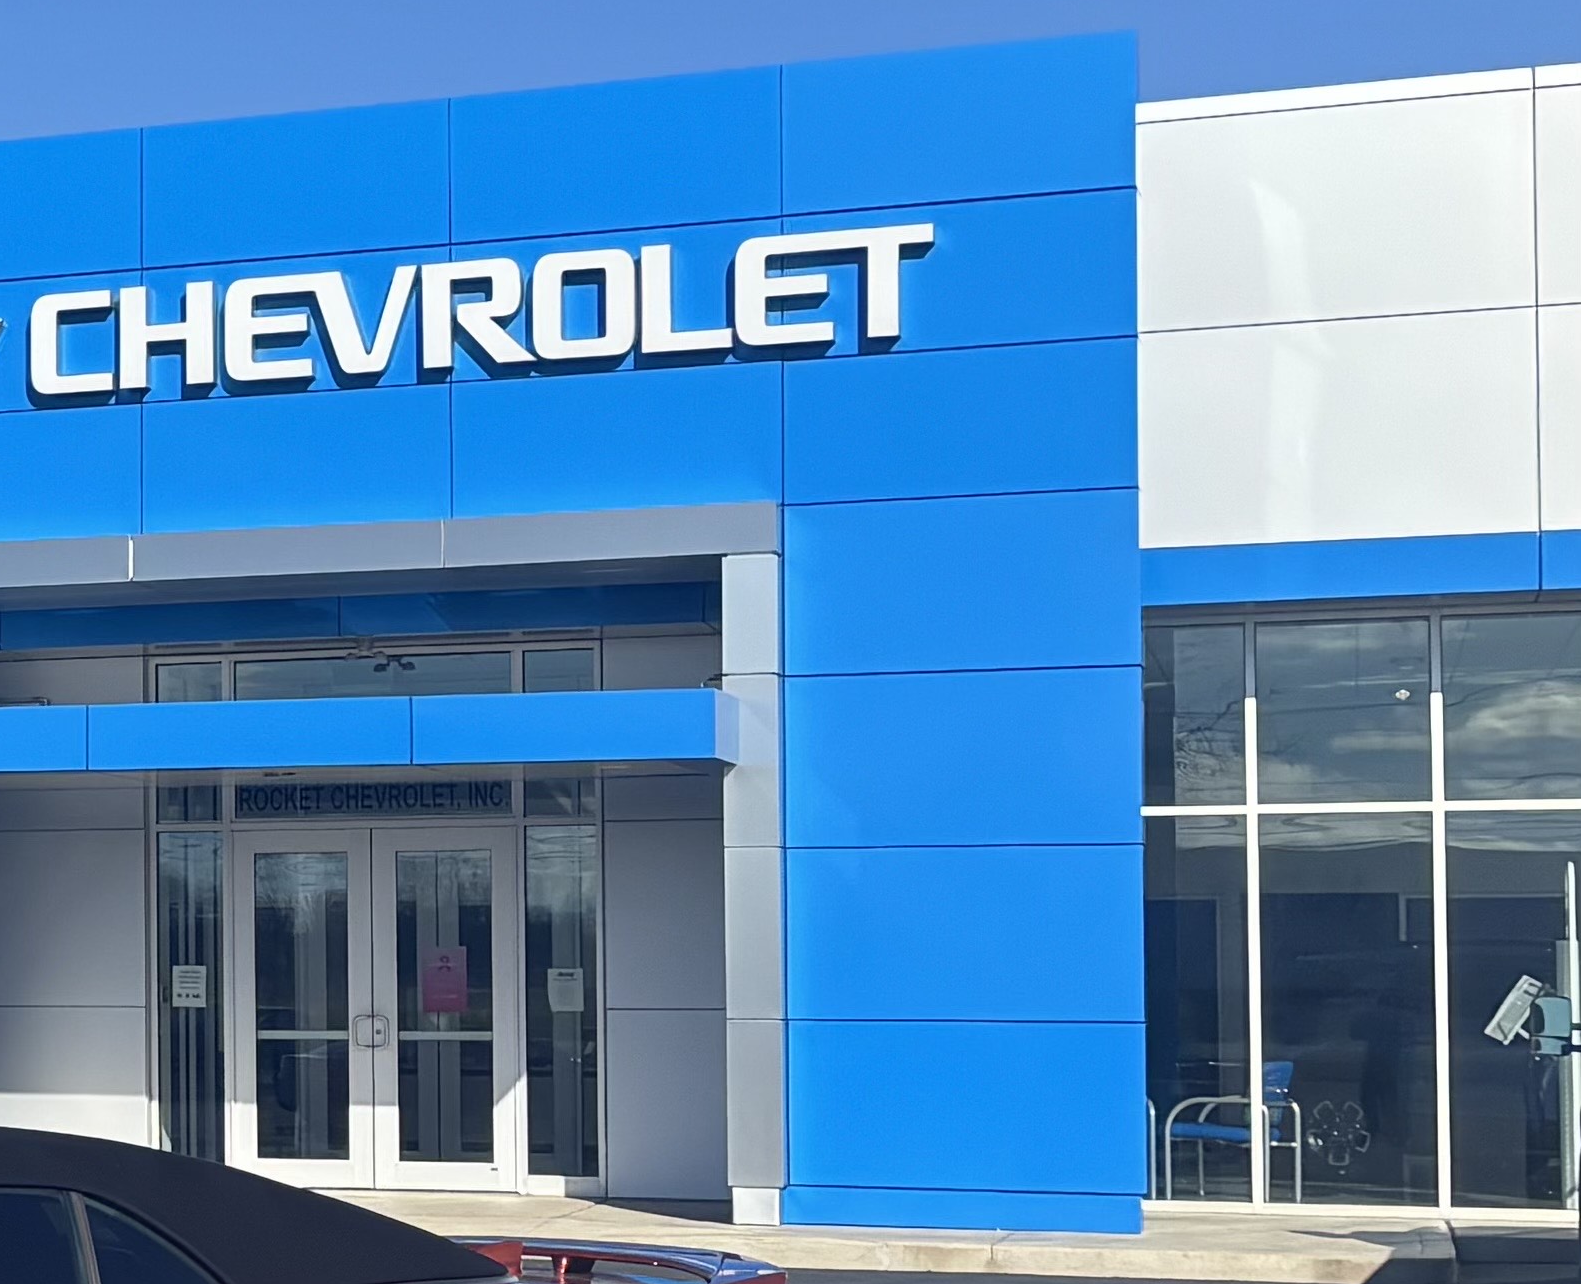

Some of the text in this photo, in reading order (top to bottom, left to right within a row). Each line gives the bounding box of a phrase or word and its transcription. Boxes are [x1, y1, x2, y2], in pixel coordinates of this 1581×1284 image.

[29, 221, 935, 397] CHEVROLET
[240, 781, 510, 812] ROCKET CHEVROLET, INC.
